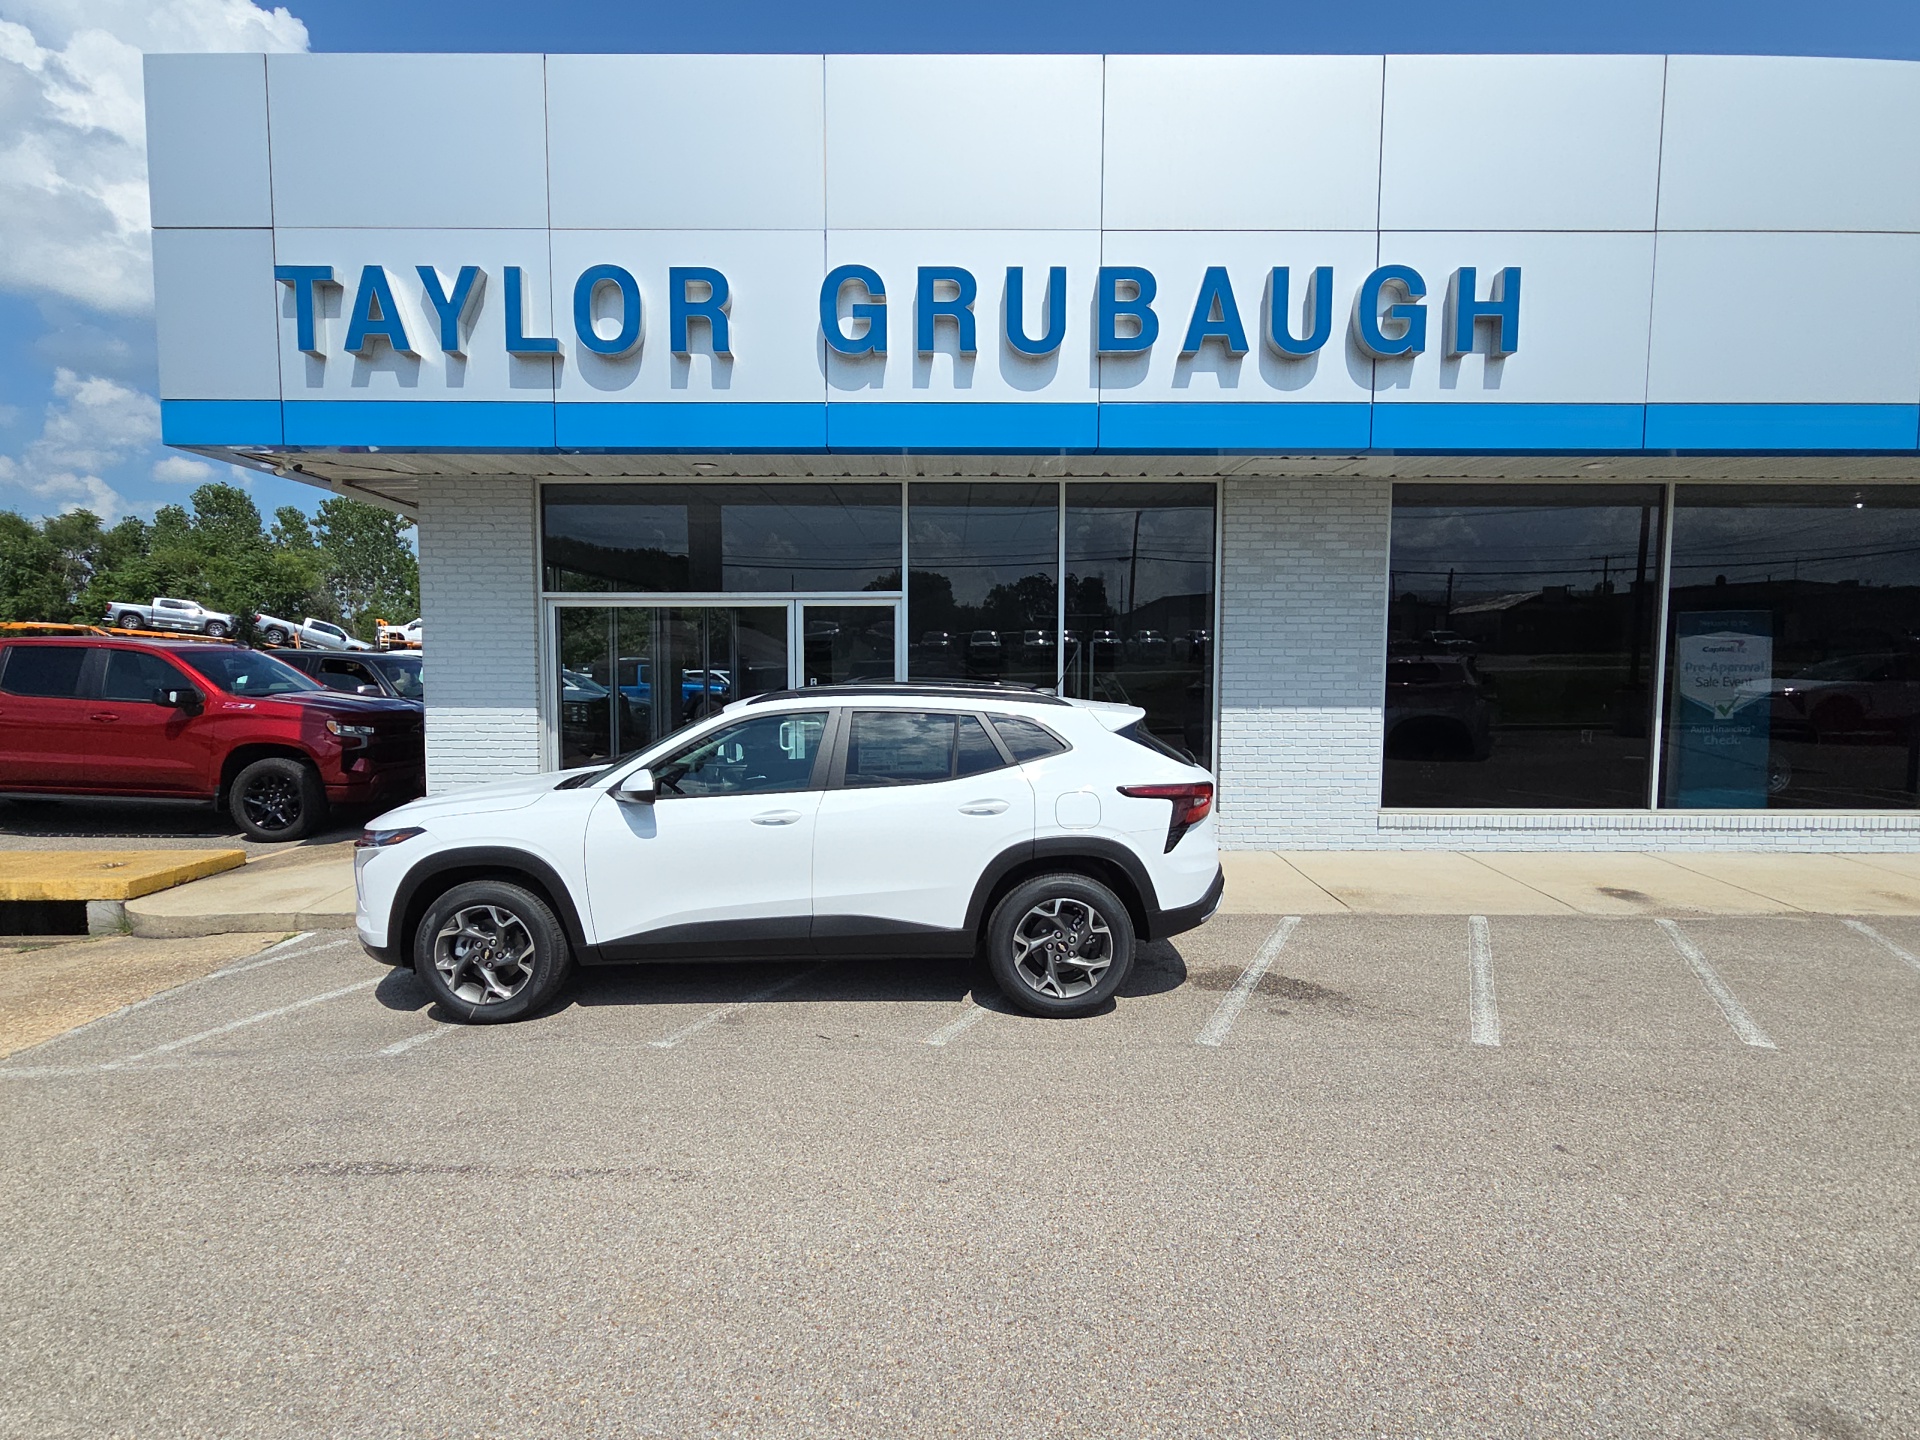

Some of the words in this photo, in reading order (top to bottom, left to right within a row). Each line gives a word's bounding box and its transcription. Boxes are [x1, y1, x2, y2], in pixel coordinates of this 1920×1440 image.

[274, 263, 733, 356] TAYLOR
[819, 263, 1521, 357] GRUBAUGH
[1685, 661, 1765, 675] Pre-Approval
[1695, 676, 1719, 688] Sale
[1722, 676, 1752, 688] Event
[1690, 725, 1711, 733] Auto
